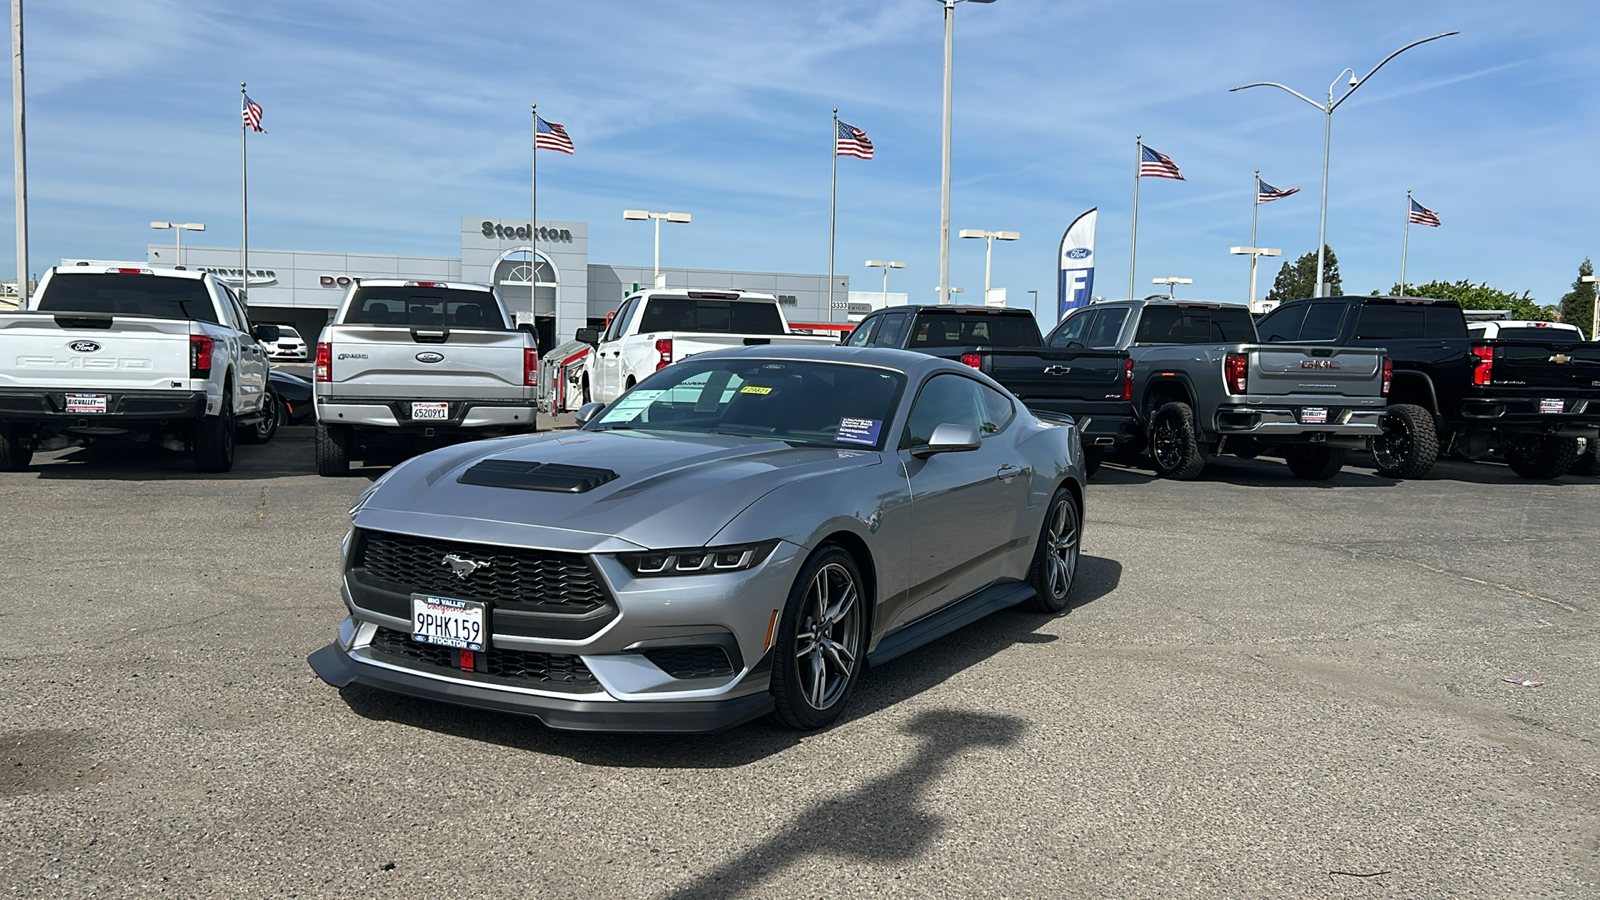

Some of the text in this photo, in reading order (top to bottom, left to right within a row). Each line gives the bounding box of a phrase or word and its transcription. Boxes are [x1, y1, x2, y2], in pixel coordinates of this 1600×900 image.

[481, 221, 571, 241] Stockton
[1070, 249, 1087, 258] Ford
[73, 341, 97, 352] Ford
[420, 353, 439, 361] Ford
[16, 356, 153, 370] F-150
[1300, 360, 1340, 369] GMC
[414, 409, 446, 418] 65209Y1
[440, 599, 466, 608] VALLEY
[417, 612, 480, 642] 9PHK159
[427, 636, 467, 648] STOCKTON
